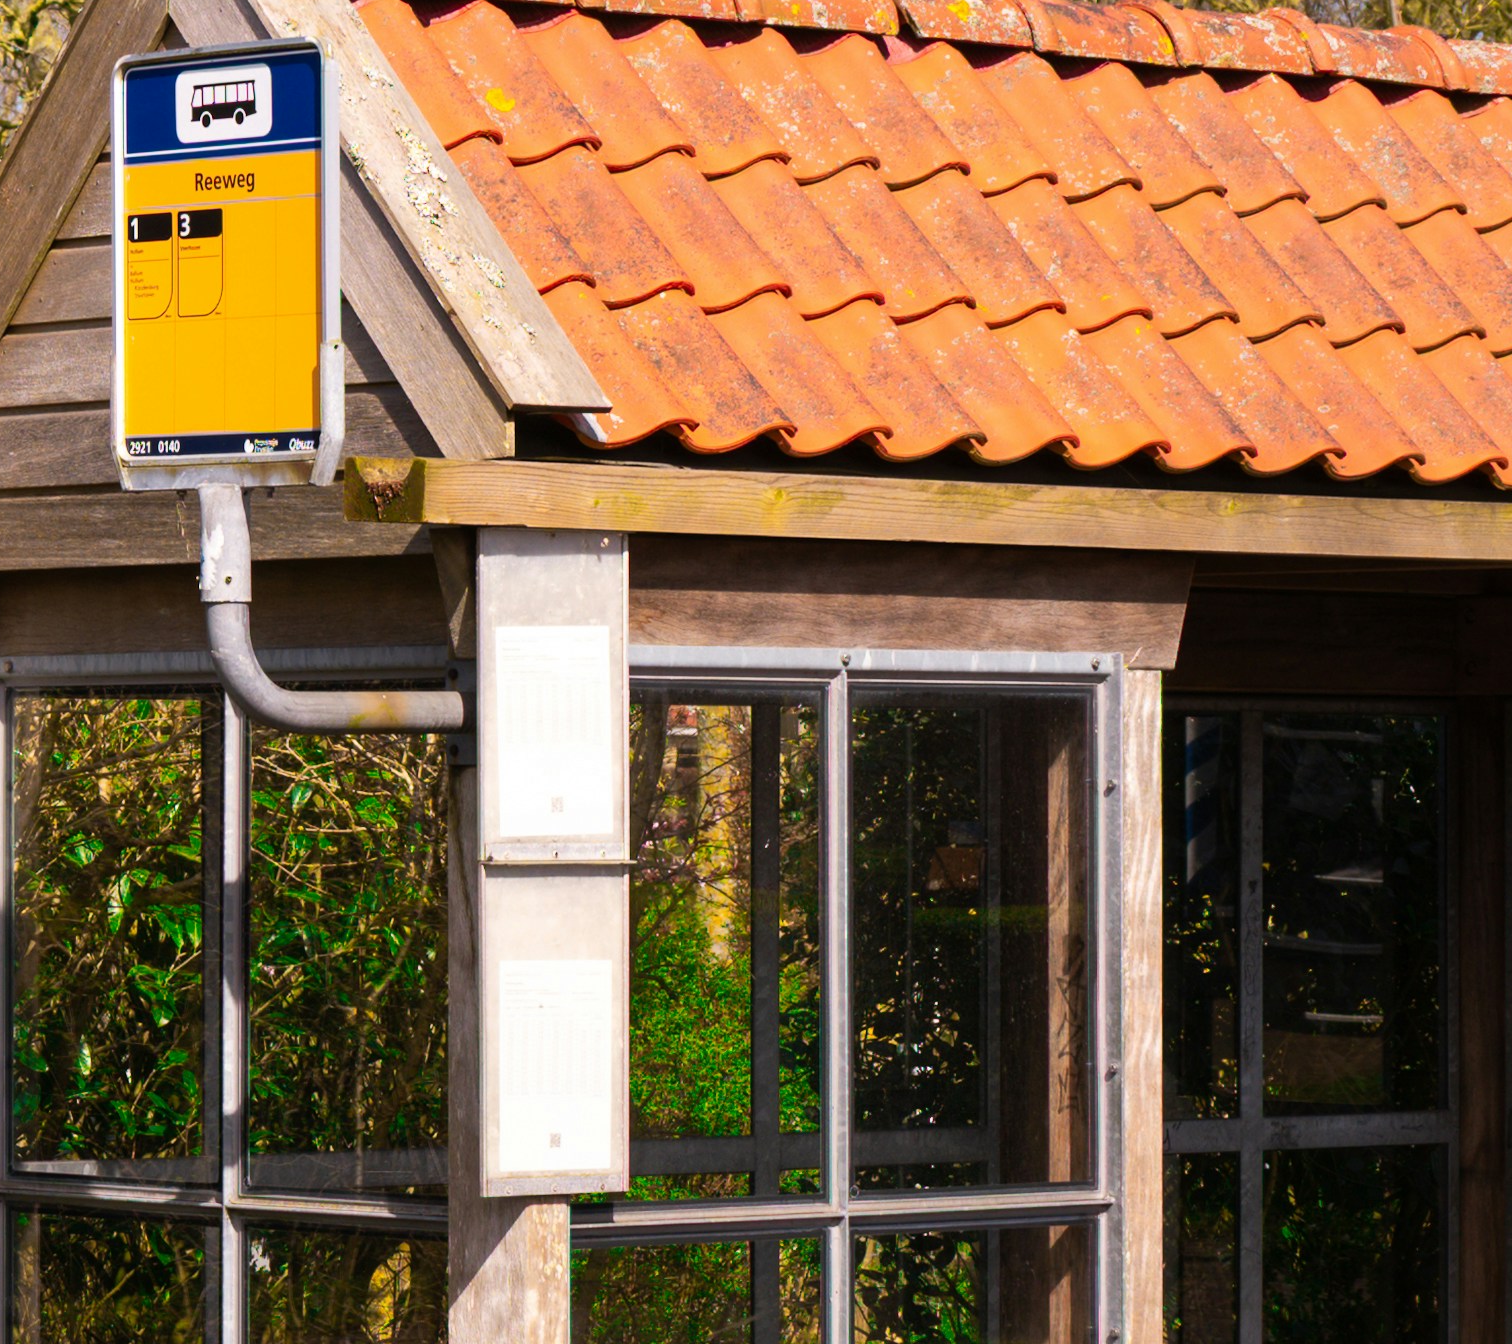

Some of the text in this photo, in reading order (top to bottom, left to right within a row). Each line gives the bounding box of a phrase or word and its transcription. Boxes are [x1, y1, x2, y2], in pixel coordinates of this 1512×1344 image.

[194, 171, 255, 192] Reeweg
[130, 217, 139, 240] 1
[179, 213, 191, 237] 3
[130, 440, 181, 454] 2921 0140
[289, 437, 315, 452] Qbuzz
